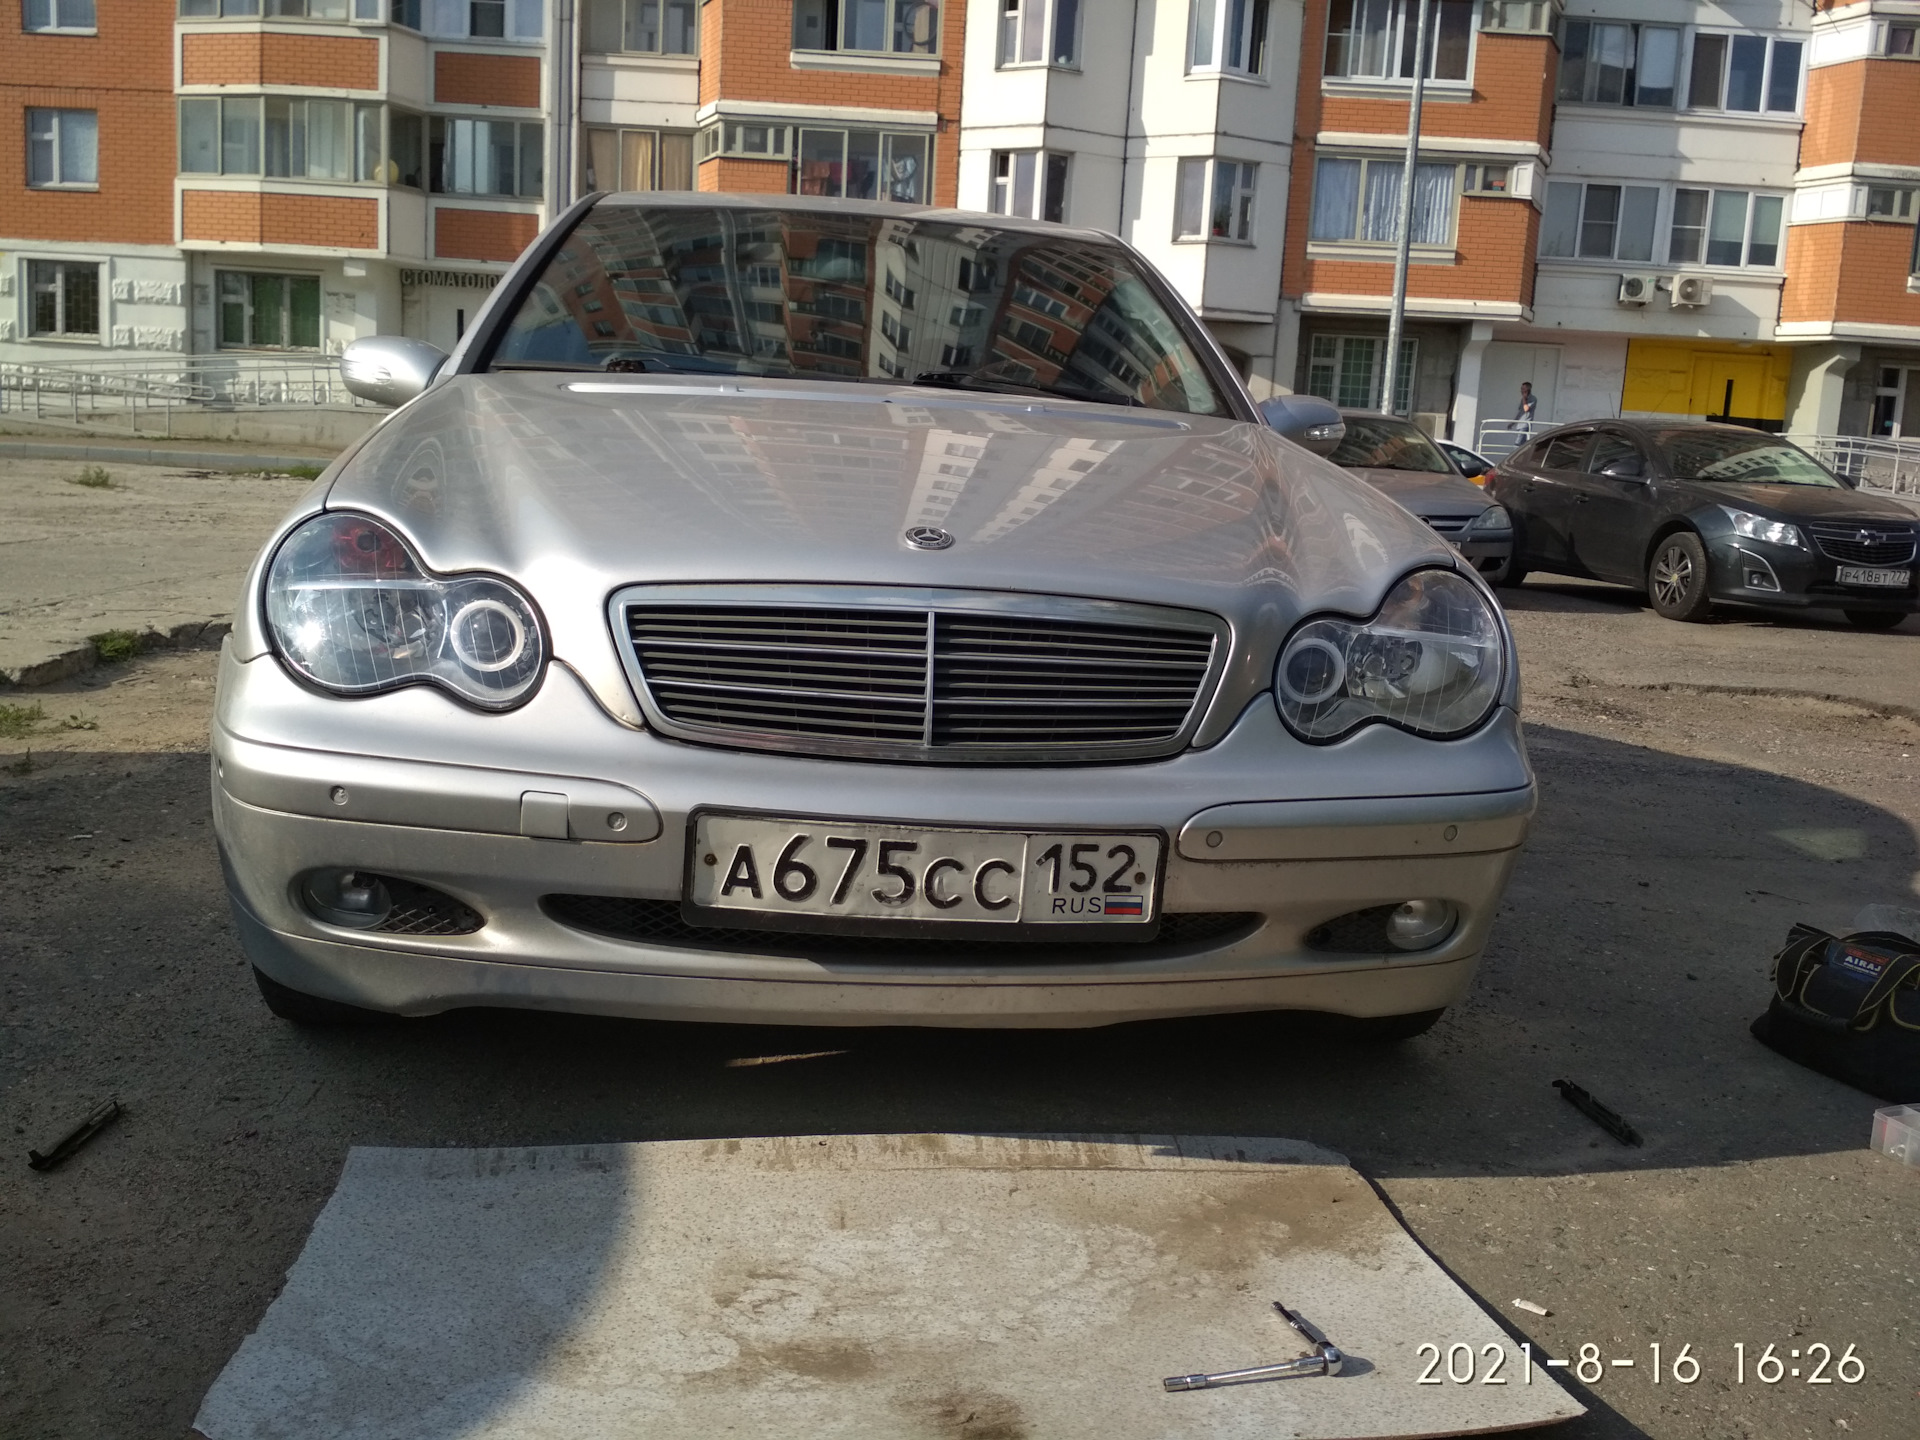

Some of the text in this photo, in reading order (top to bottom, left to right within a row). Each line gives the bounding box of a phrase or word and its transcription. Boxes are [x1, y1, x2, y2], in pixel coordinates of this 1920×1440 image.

[401, 269, 504, 289] СТОМАТОЛО
[719, 832, 1136, 911] A675CC 152
[1051, 896, 1102, 914] RUS
[1844, 955, 1882, 972] AIRAJ
